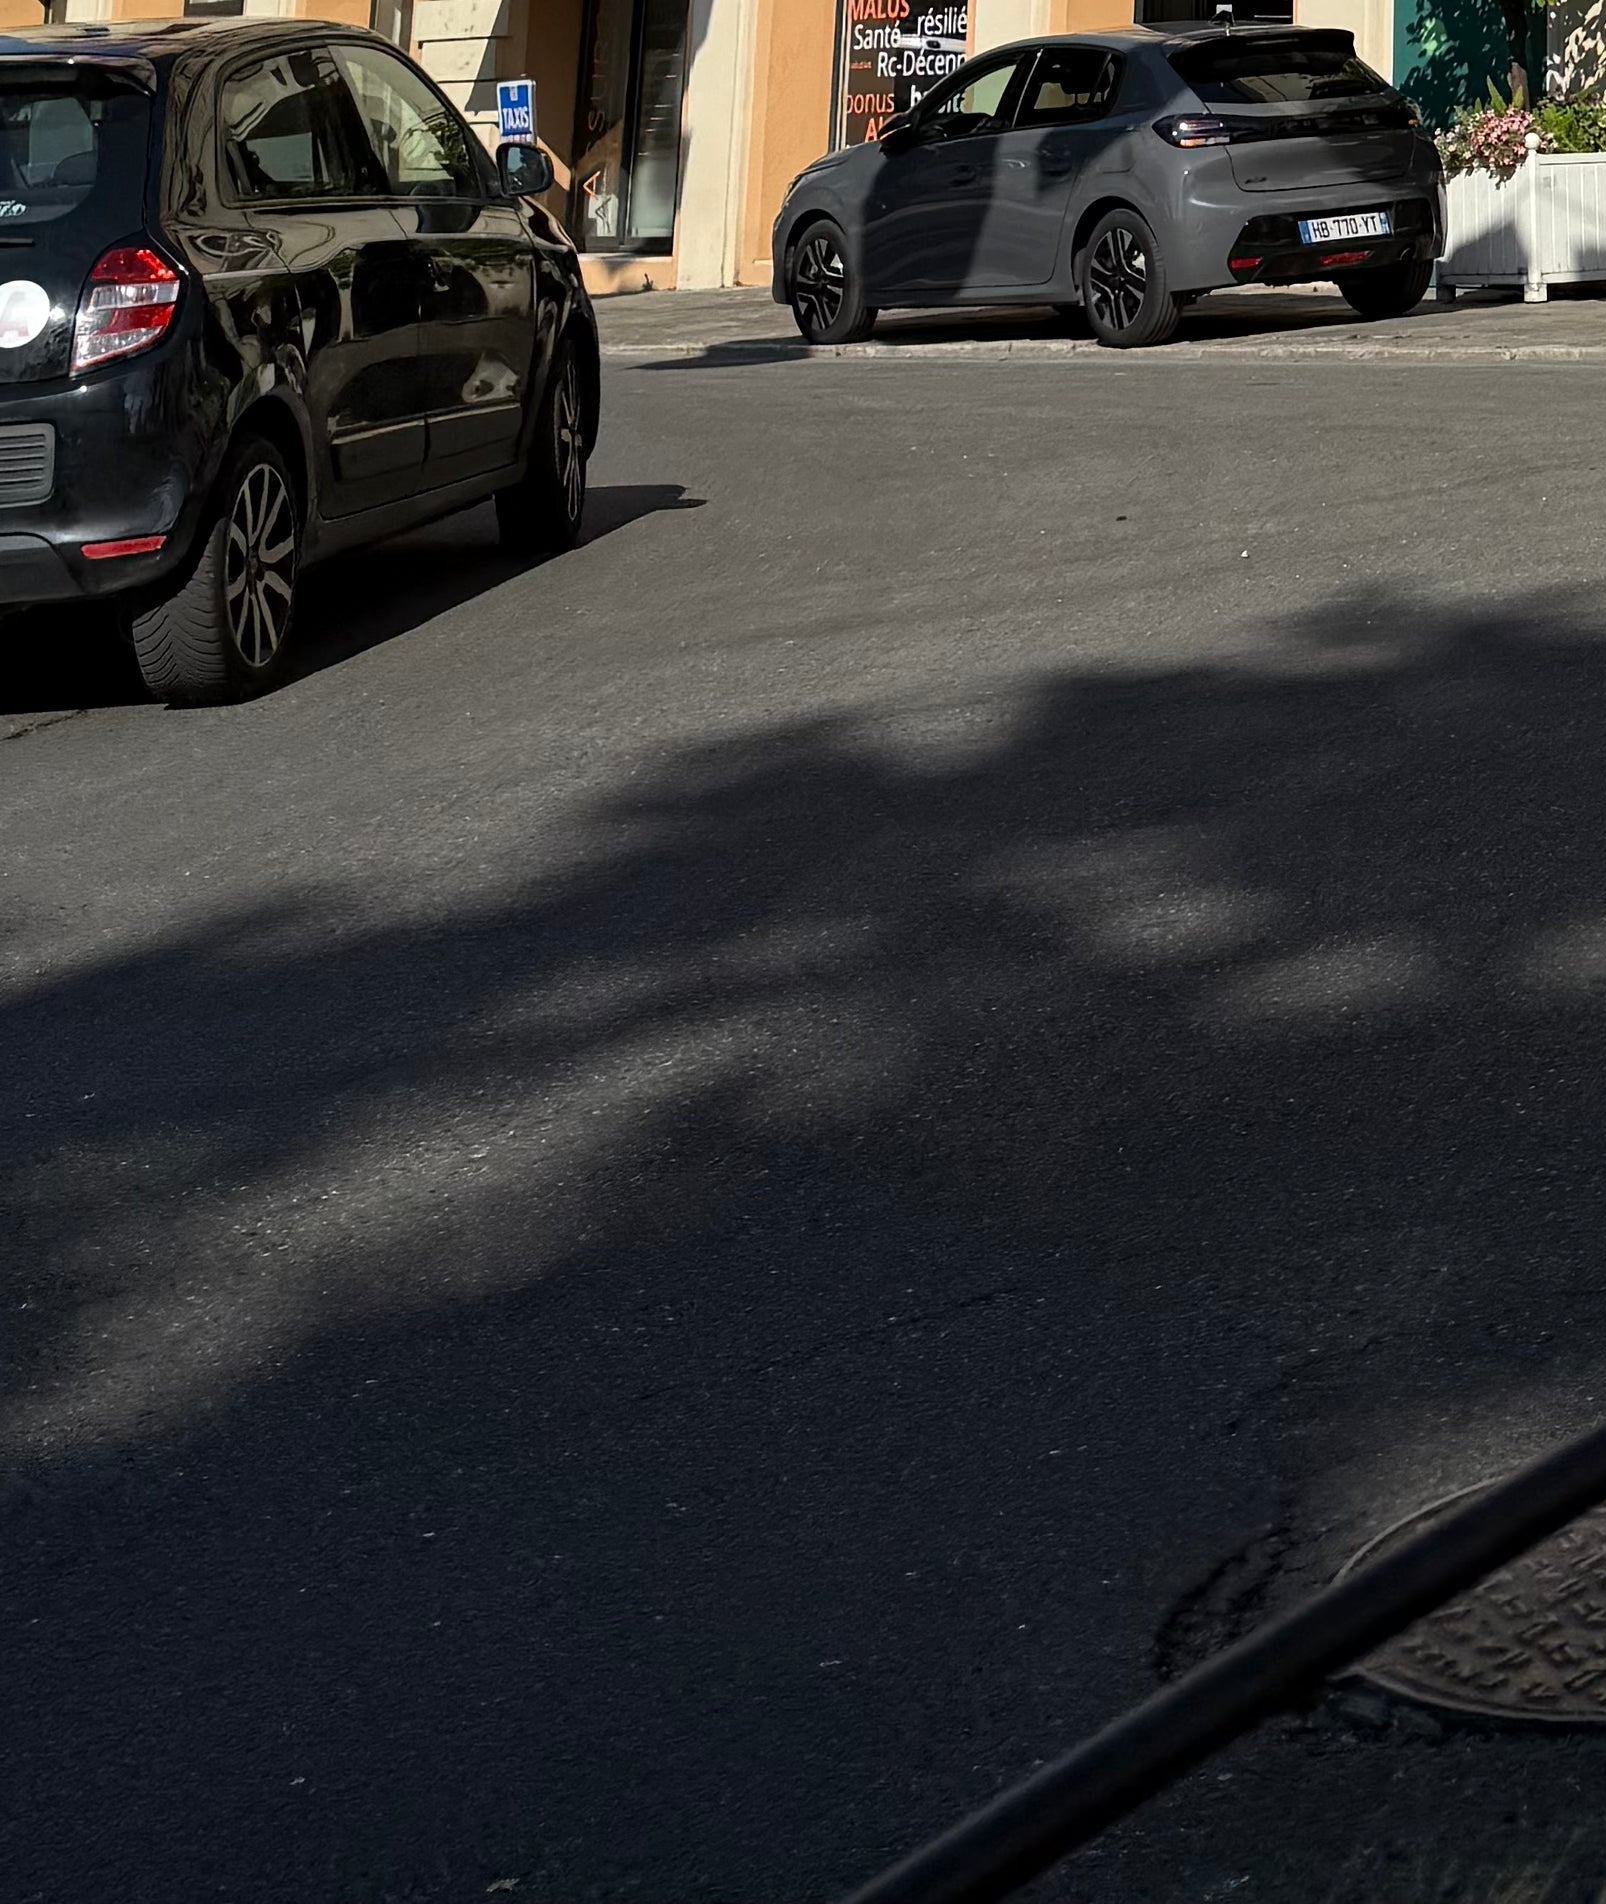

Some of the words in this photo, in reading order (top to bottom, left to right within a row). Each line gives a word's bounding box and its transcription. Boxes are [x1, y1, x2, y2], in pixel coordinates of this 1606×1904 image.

[853, 20, 901, 50] Santé
[502, 106, 529, 129] TAXIS
[1311, 216, 1378, 239] HB-770-YT
